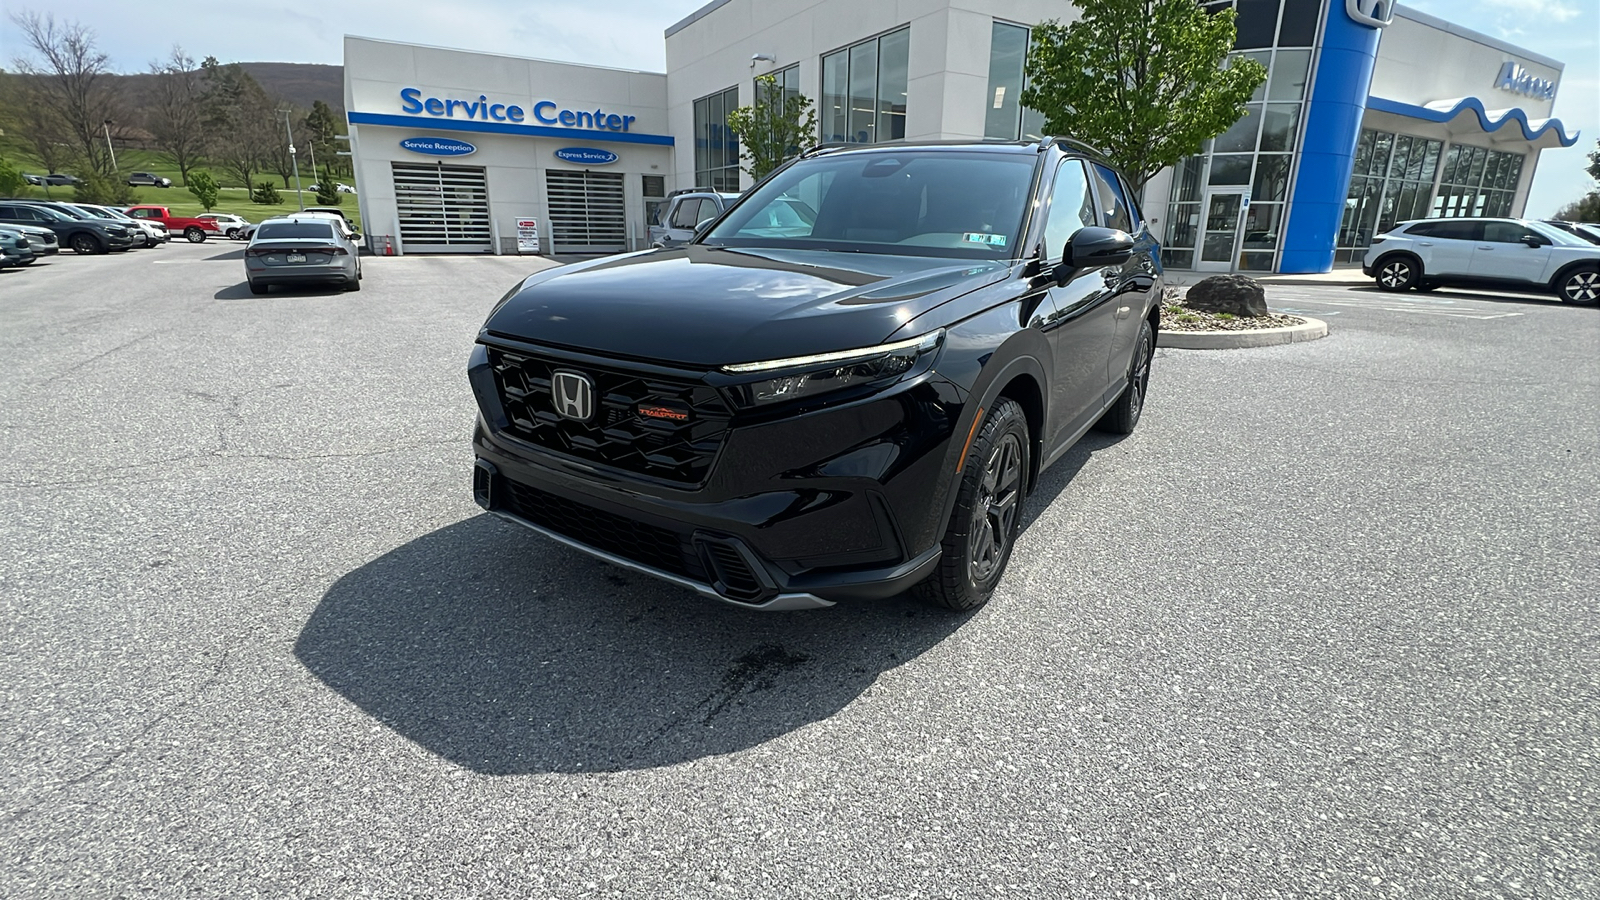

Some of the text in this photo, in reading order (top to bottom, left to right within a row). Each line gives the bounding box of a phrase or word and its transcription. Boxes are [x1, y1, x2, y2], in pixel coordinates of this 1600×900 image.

[400, 87, 636, 132] Service Center
[404, 140, 472, 152] Service Reception
[558, 150, 606, 160] Express Service
[639, 408, 688, 420] TRAILSPORT
